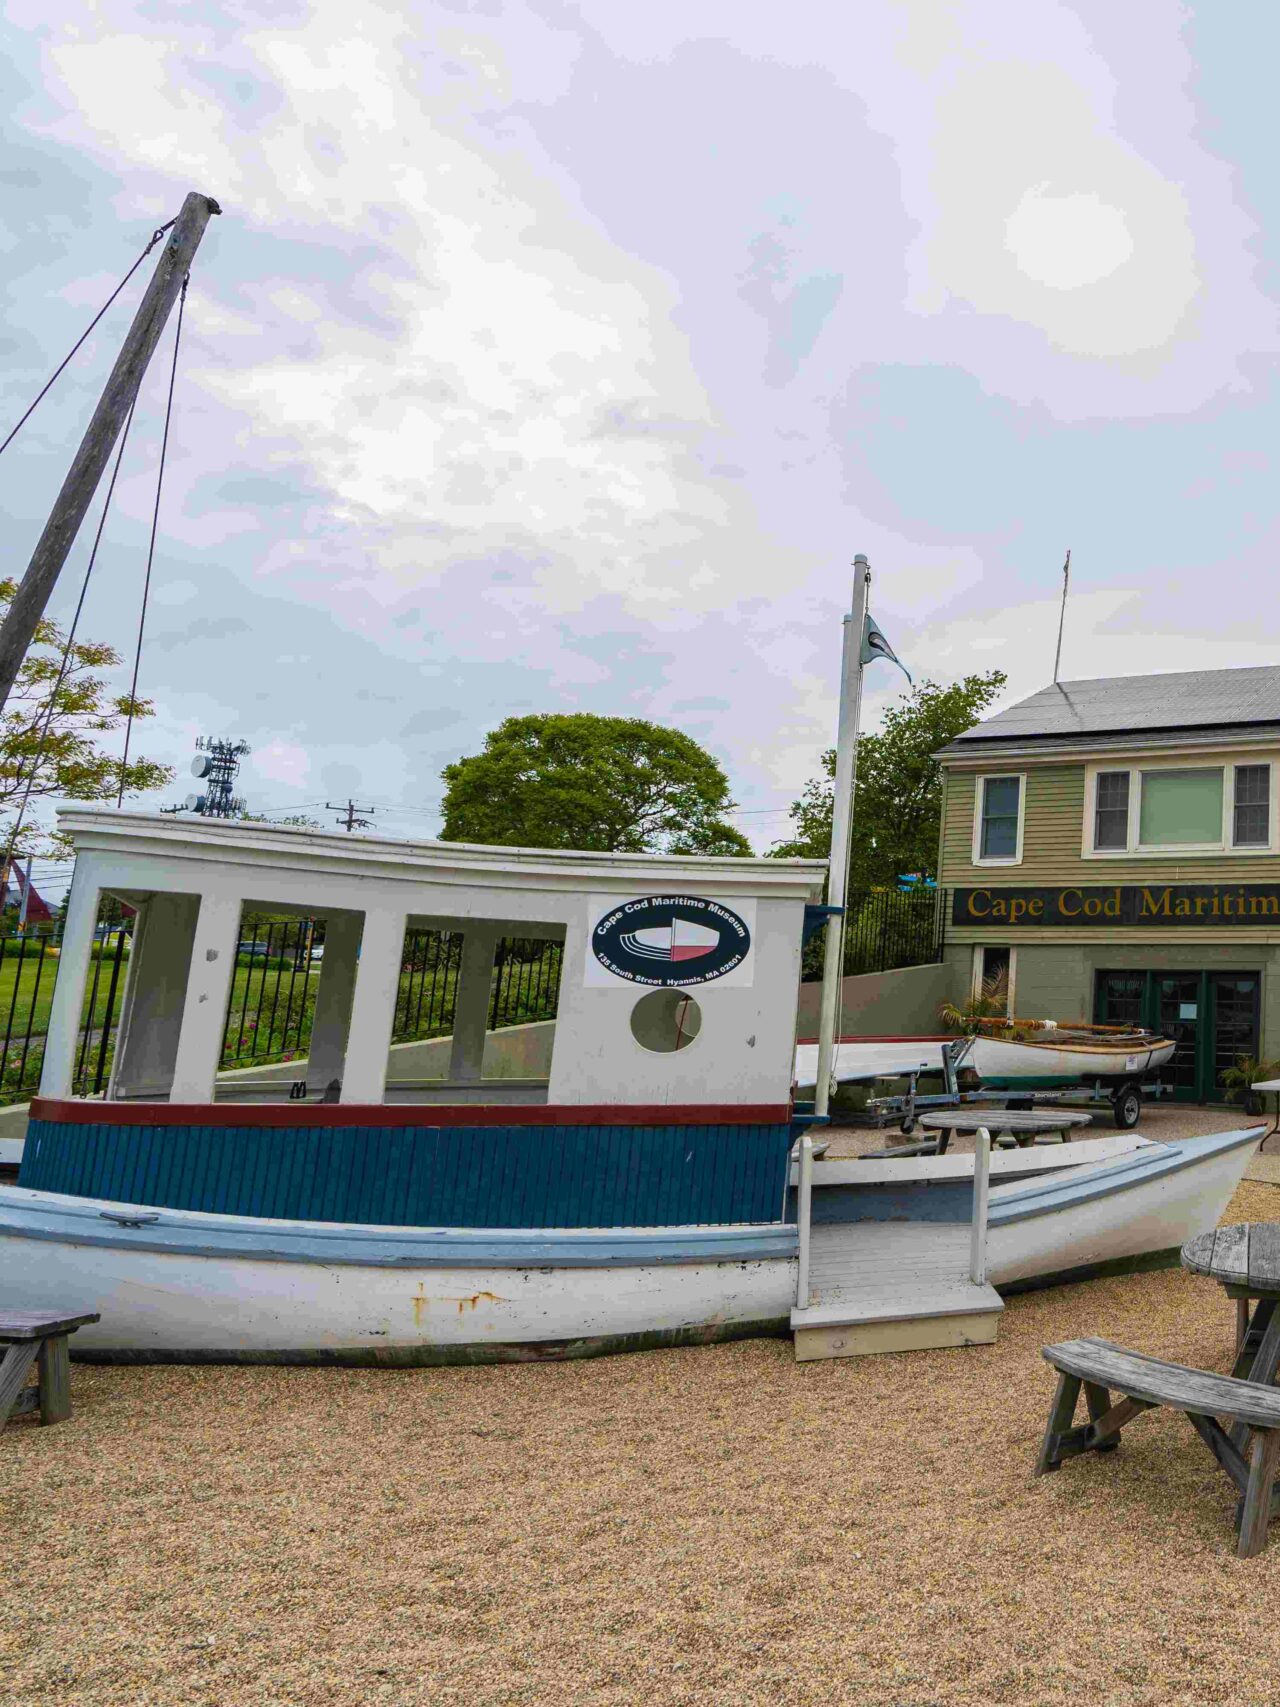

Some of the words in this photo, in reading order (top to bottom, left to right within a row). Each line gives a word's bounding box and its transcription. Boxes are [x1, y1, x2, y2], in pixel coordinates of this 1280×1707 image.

[597, 911, 624, 935] Cape
[624, 900, 649, 913] Cod
[652, 897, 706, 909] Maritime
[707, 903, 746, 938] Museum
[968, 889, 1044, 923] Cape
[1058, 888, 1122, 917] Cod
[598, 952, 611, 966] 135
[610, 964, 634, 980] South
[634, 974, 662, 985] Street
[667, 976, 705, 987] Hyannis,
[705, 970, 720, 980] MA
[720, 954, 742, 973] 02601
